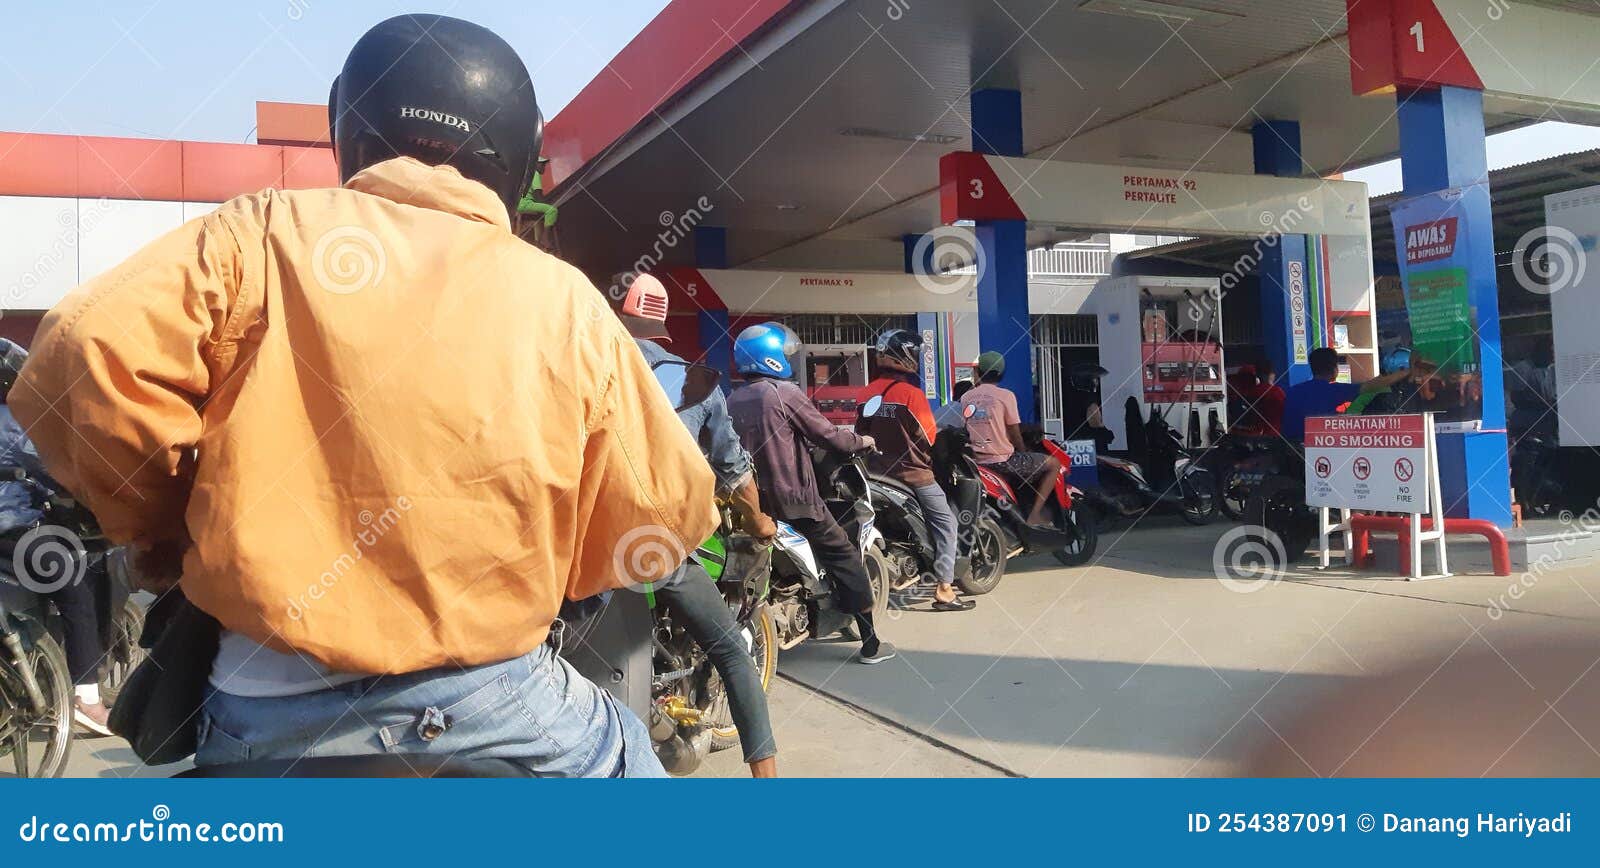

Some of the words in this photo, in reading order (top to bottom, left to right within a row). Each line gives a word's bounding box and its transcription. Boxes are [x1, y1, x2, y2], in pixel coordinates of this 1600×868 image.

[1409, 21, 1425, 53] 1
[400, 107, 471, 133] HONDA
[969, 178, 984, 199] 3
[1123, 175, 1180, 189] PERTAMAX
[1183, 180, 1197, 191] 92
[1407, 224, 1447, 249] AWAS
[800, 278, 842, 287] PERTAMAX
[844, 279, 854, 287] 92
[687, 283, 698, 297] 5
[1324, 418, 1386, 430] PERHATIAN
[1314, 436, 1336, 447] NO
[1339, 435, 1414, 447] SMOKING
[1398, 486, 1410, 494] NO
[1396, 494, 1413, 503] FIRE
